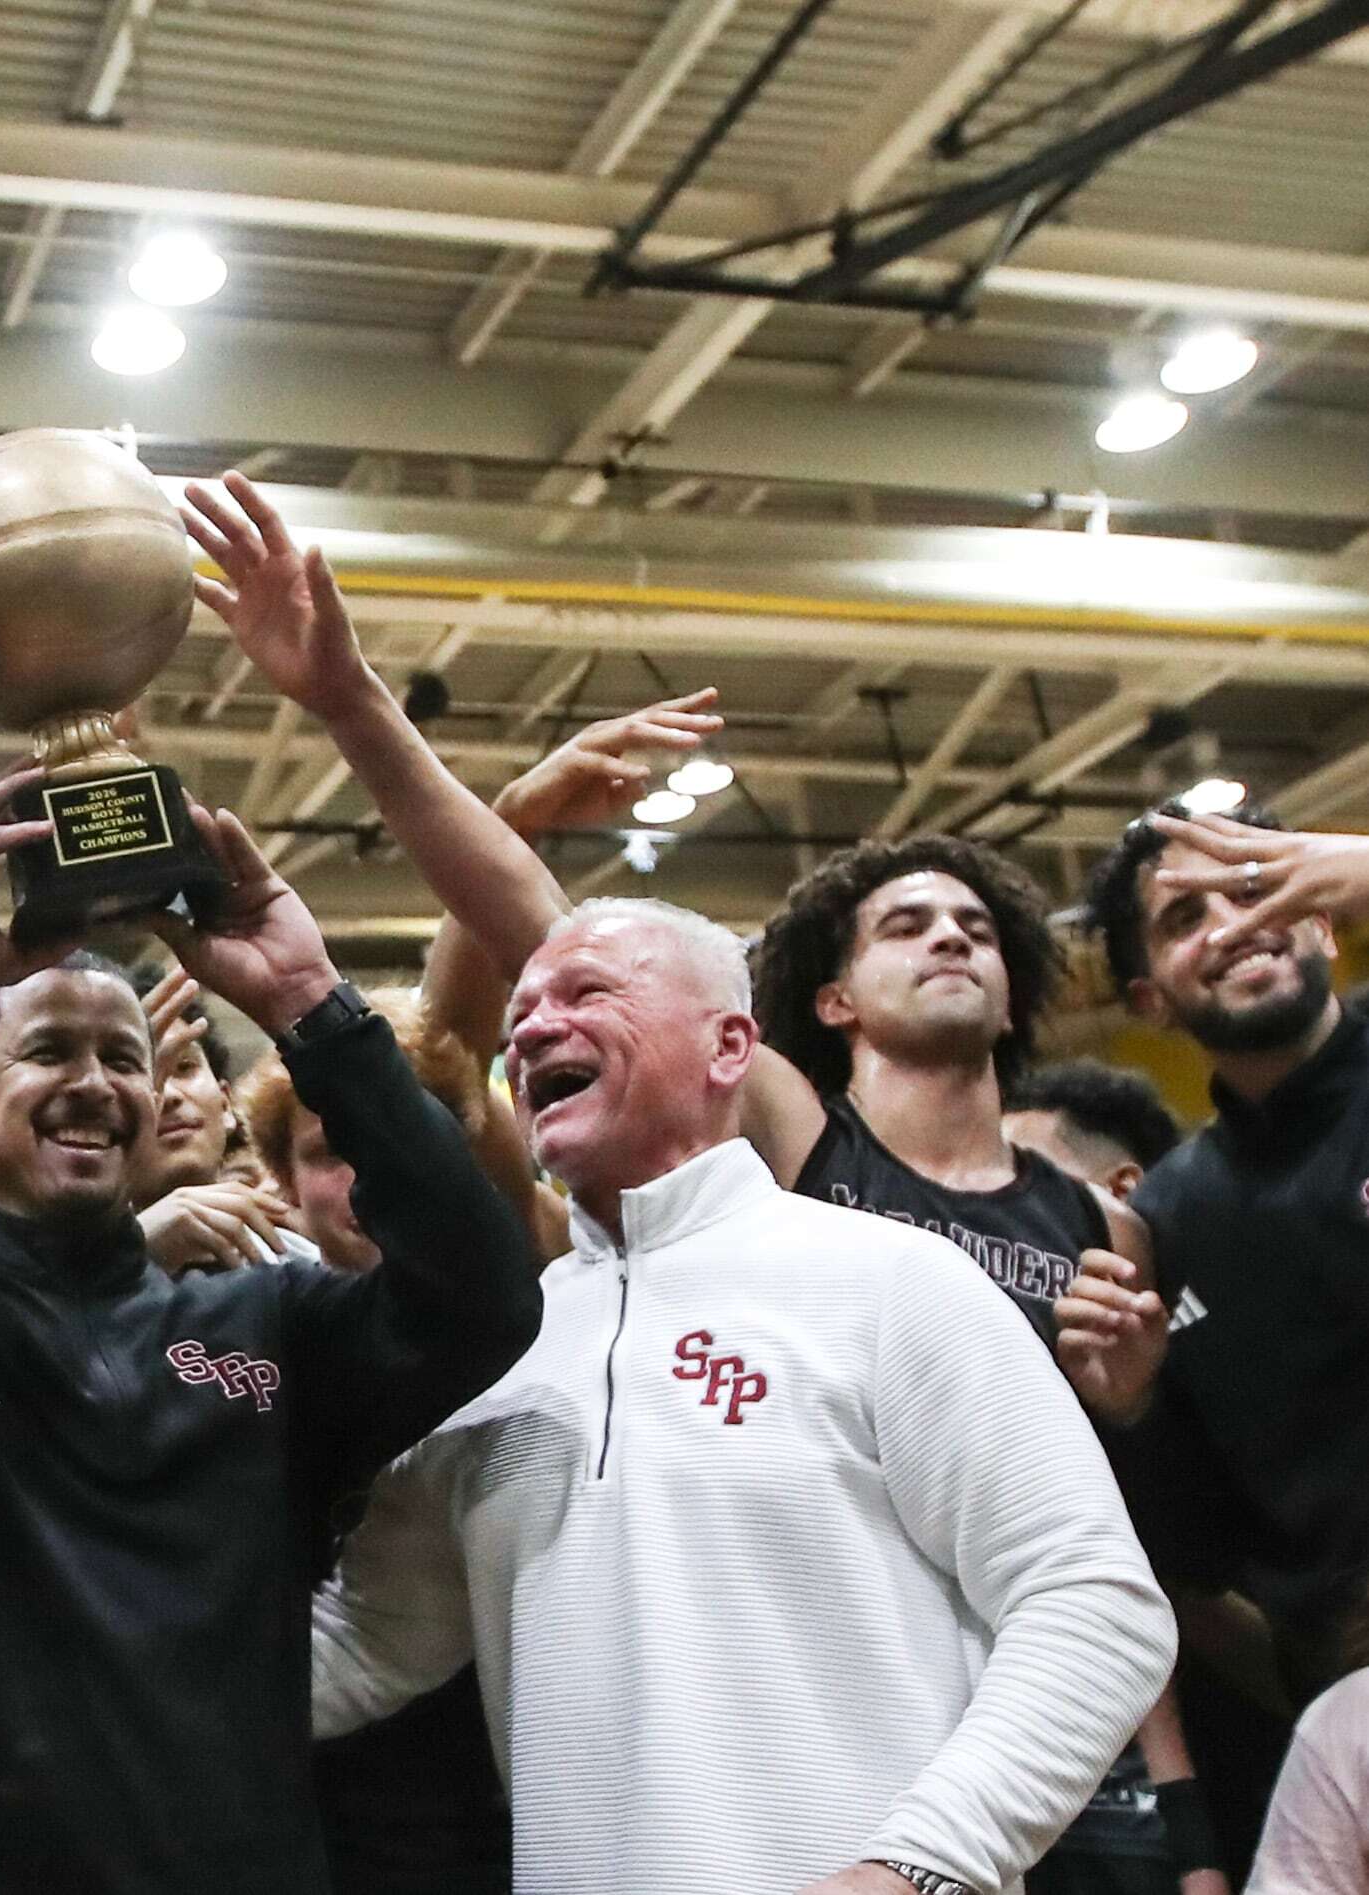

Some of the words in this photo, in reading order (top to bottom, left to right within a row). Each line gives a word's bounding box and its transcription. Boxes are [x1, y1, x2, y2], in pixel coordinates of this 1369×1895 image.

[88, 788, 117, 801] 2026
[62, 802, 105, 816] HUDSON
[106, 794, 146, 808] COUNTY
[91, 808, 124, 820] BOYS
[72, 813, 145, 834] BASKETBALL
[80, 831, 148, 850] CHAMPIONS
